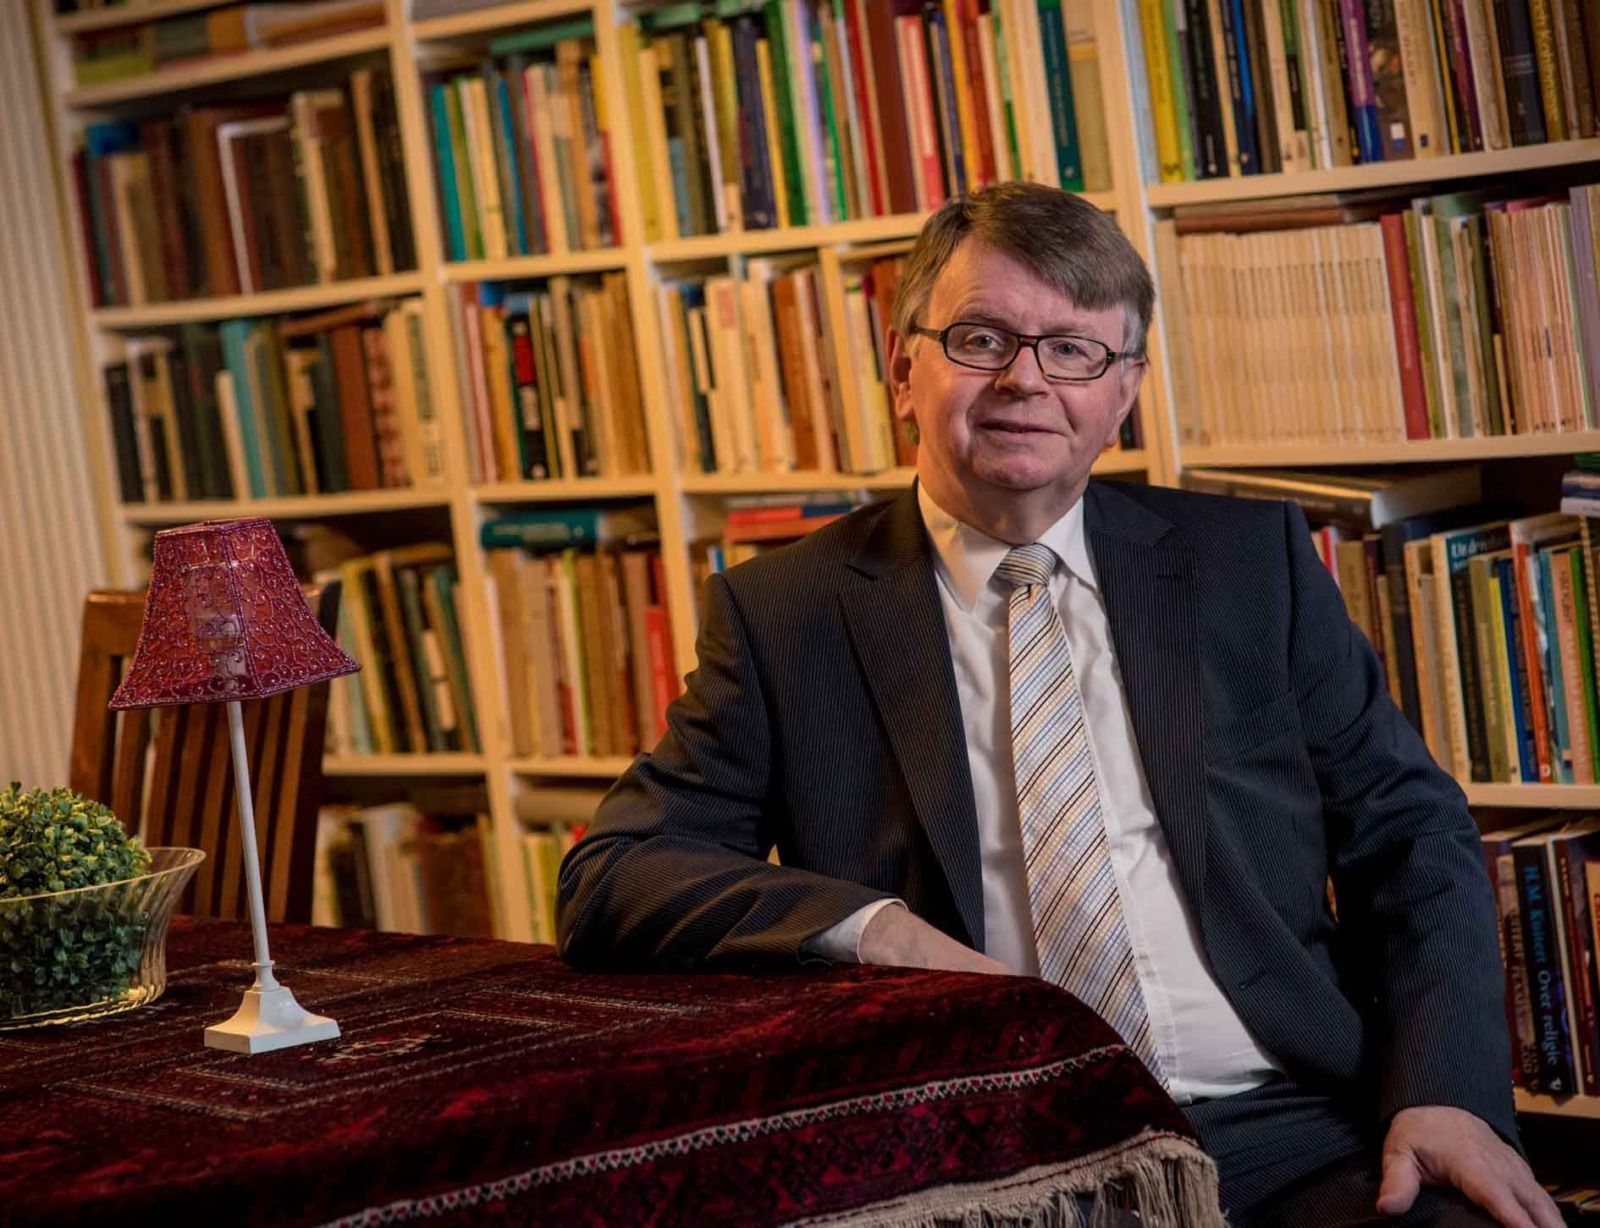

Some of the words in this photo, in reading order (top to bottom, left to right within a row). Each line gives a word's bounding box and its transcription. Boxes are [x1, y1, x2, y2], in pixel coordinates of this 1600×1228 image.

[1530, 910, 1547, 962] Kuitert
[1537, 968, 1553, 1009] Over
[1542, 1014, 1560, 1066] religie
